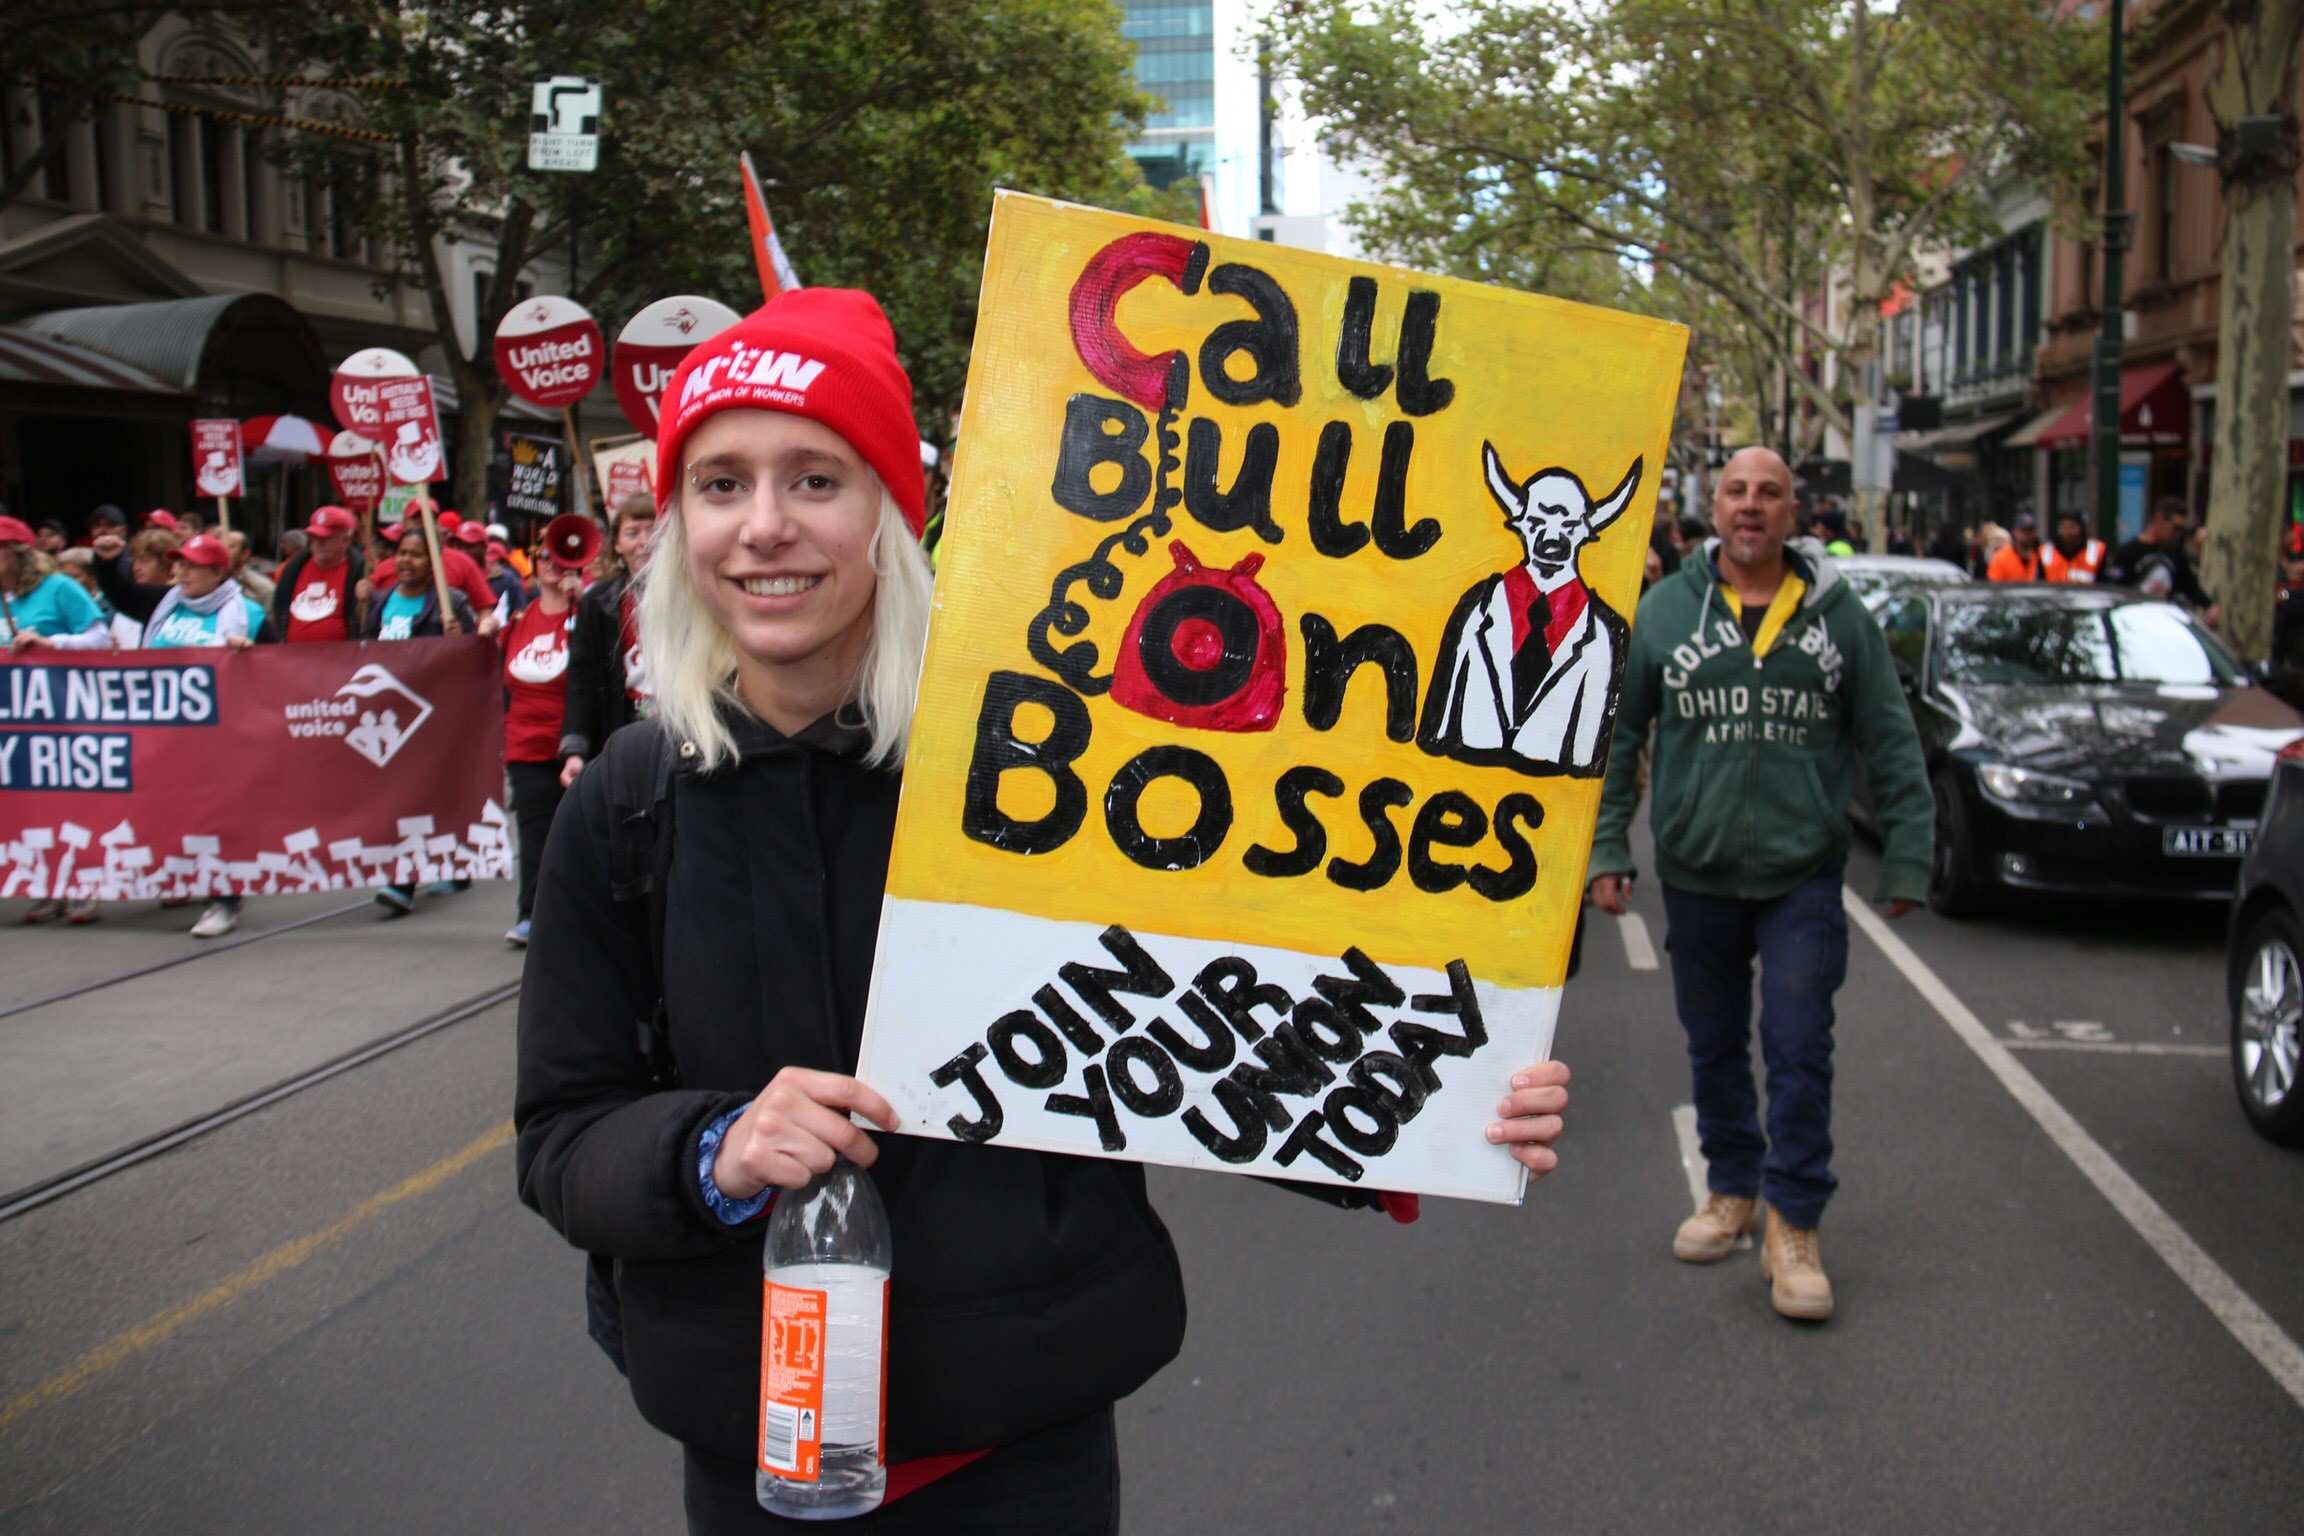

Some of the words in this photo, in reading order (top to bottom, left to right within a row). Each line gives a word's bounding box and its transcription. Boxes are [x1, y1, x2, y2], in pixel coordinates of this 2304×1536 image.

[508, 333, 592, 369] United
[1069, 231, 1455, 417] Call
[520, 363, 590, 390] Voice
[734, 386, 750, 398] OF
[752, 386, 805, 407] WORKERS
[1051, 391, 1443, 561] Bull
[65, 667, 212, 722] NEEDS
[285, 696, 356, 719] united
[1678, 685, 1750, 720] OHIO
[288, 717, 347, 738] voice
[29, 734, 128, 789] RISE
[961, 669, 1546, 902] Bosses
[930, 925, 1175, 1144] JOIN
[1045, 956, 1296, 1152] YOUR
[1181, 945, 1407, 1165] UNION
[1273, 958, 1489, 1183] TODAY
